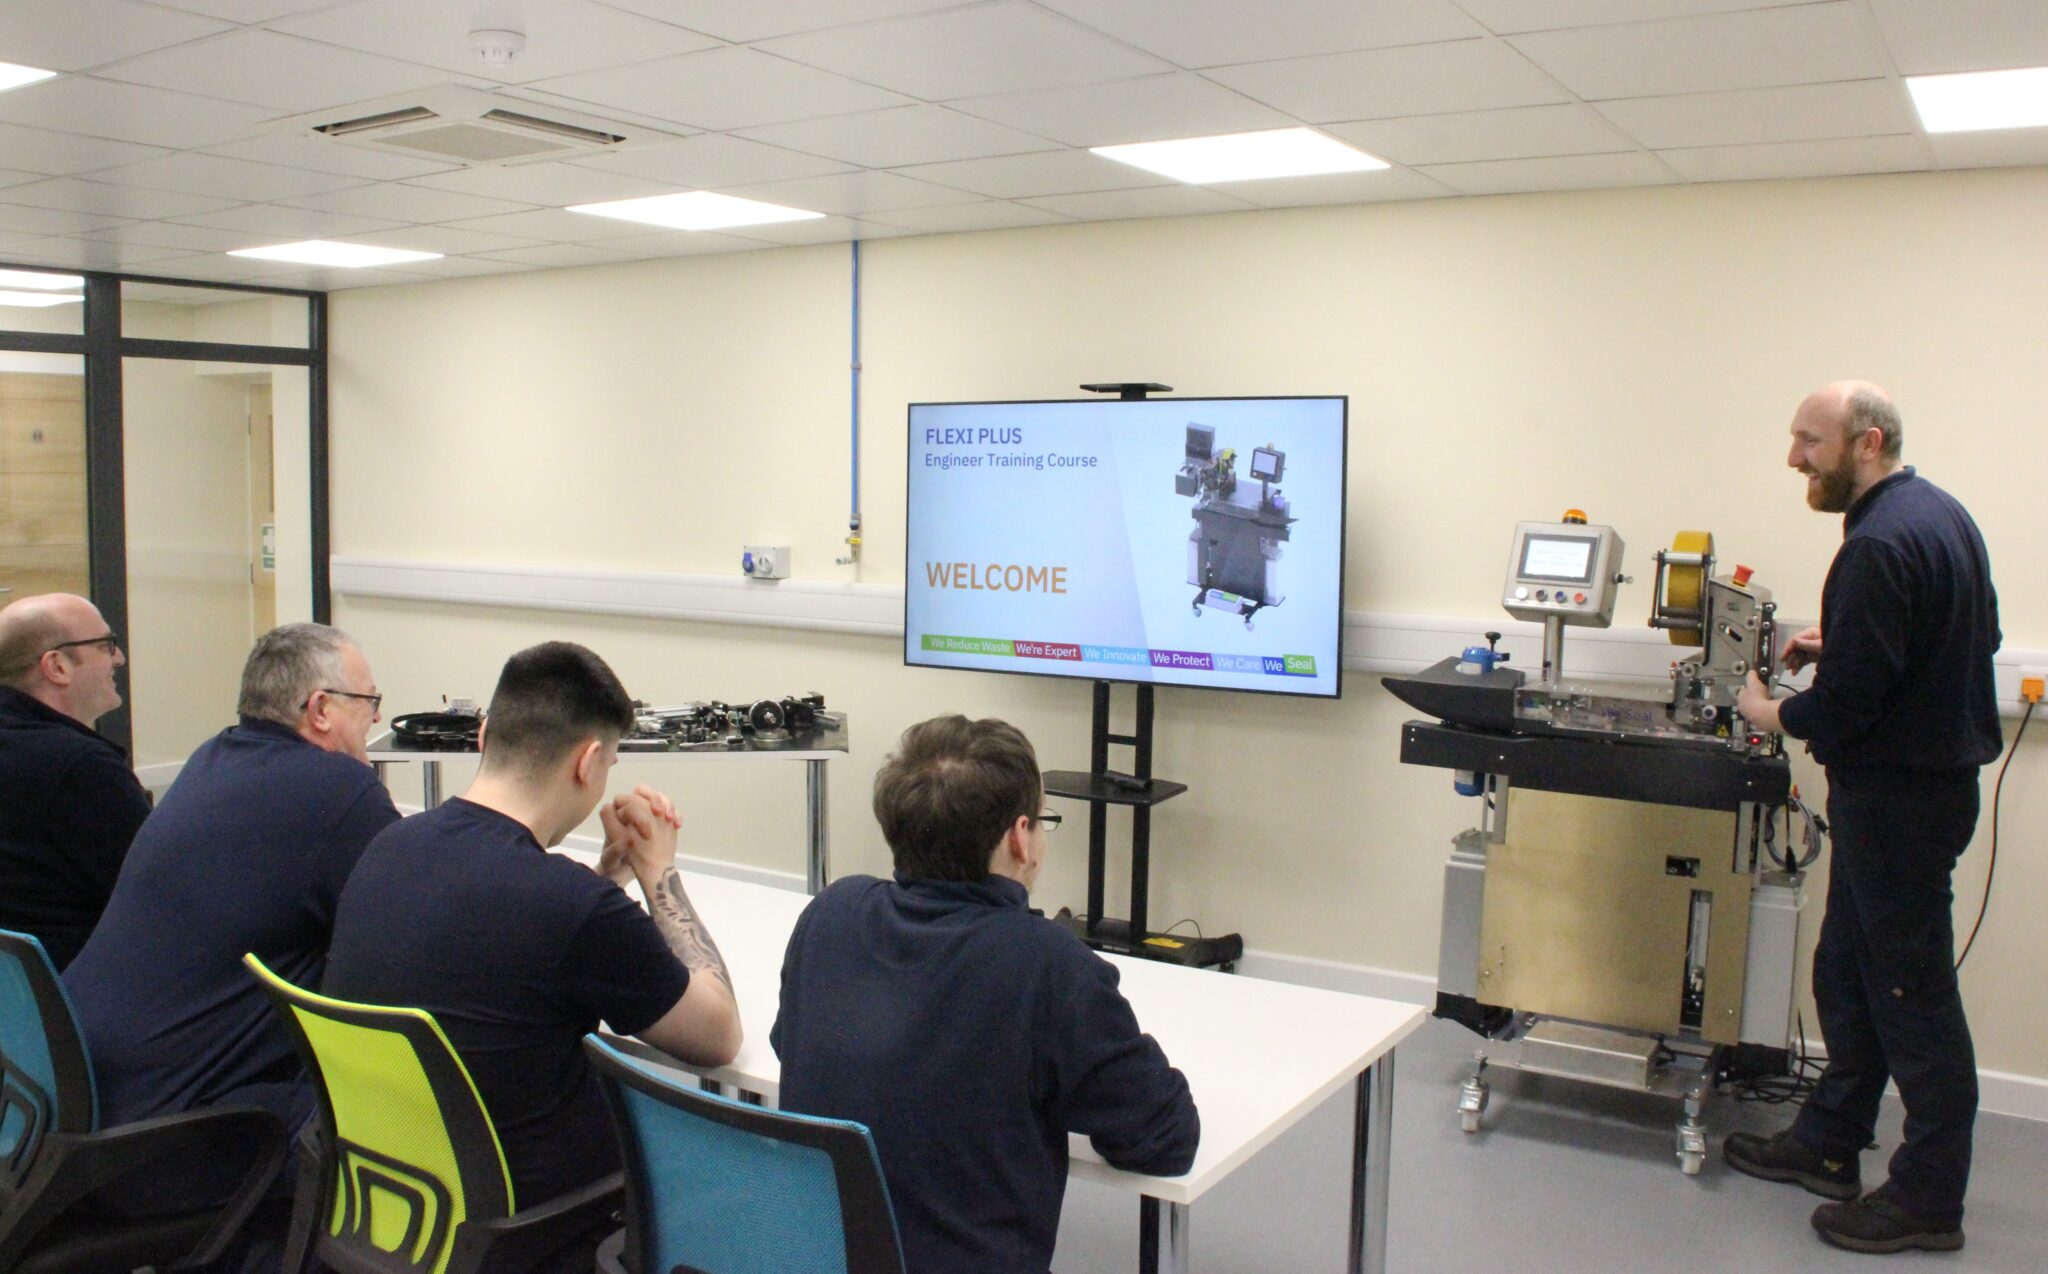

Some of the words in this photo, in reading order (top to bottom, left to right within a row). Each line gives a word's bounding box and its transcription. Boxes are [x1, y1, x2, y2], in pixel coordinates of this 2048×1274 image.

[925, 428, 973, 445] FLEXI
[978, 427, 1022, 444] PLUS
[925, 453, 984, 470] Engineer
[987, 452, 1044, 470] Training
[1047, 453, 1098, 467] Course
[926, 561, 1067, 593] WELCOME
[930, 637, 945, 648] We
[947, 638, 981, 650] Reduce
[982, 641, 1010, 653] Waste
[1016, 643, 1043, 655] We're
[1045, 645, 1077, 658] Expert
[1084, 647, 1101, 659] We
[1103, 649, 1147, 662] Innovate
[1153, 652, 1170, 664] We
[1172, 654, 1210, 667] Protect
[1217, 657, 1234, 668] We
[1236, 657, 1260, 670] Care
[1264, 659, 1283, 672] We
[1287, 656, 1313, 670] Seal
